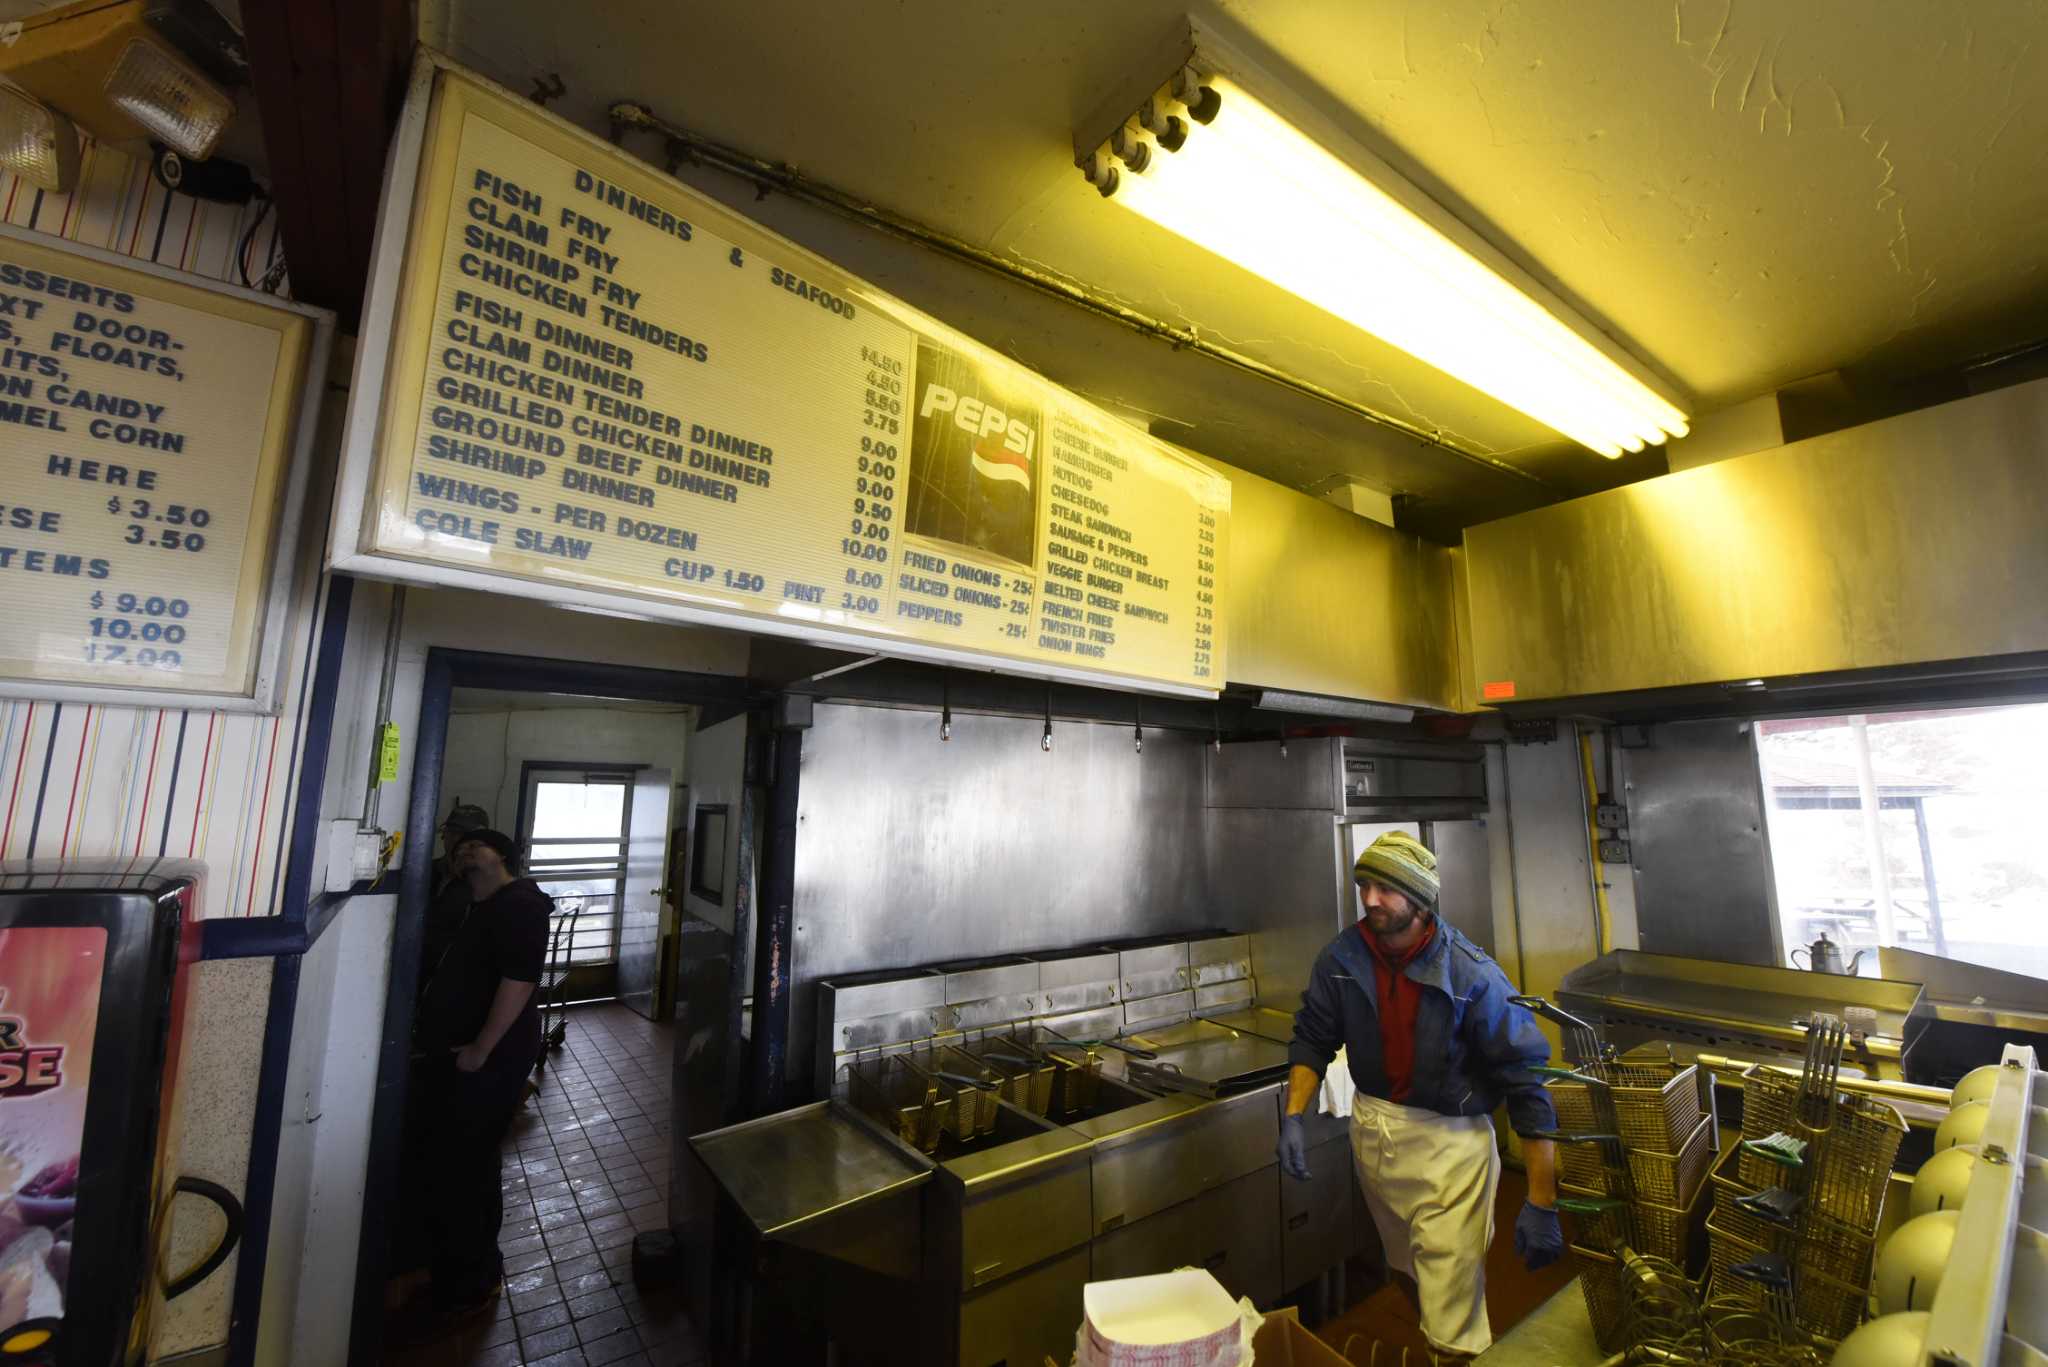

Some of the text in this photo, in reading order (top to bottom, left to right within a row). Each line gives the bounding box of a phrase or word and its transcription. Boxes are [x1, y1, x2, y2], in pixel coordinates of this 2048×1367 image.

[474, 168, 542, 217] FISH
[561, 207, 612, 246] FRY
[467, 197, 549, 247] CLAM
[568, 238, 620, 275] FRY
[575, 169, 857, 321] DINNERS & SEAFOOD
[1, 264, 135, 312] SSERTS
[464, 225, 580, 285] SHRIMP
[591, 275, 641, 311] FRY
[73, 311, 184, 350] DOOR-
[459, 253, 899, 435] CHICKEN TENDERS 3.75
[2, 348, 70, 382] ITS,
[51, 332, 184, 381] FLOATS,
[455, 290, 898, 461] FISH DINNER 9.00
[47, 384, 165, 423] CANDY
[442, 348, 894, 500] CHICKEN TENDER DINNER 9.00
[447, 320, 896, 481] CLAM DINNER 9.00
[920, 383, 1035, 461] PEPSI
[0, 400, 184, 453] MEL CORN
[436, 376, 893, 521] GRILLED CHICKEN DINNER 9.50
[48, 455, 157, 490] HERE
[431, 406, 890, 541] GROUND BEEF DINNER 9.00
[416, 472, 520, 515] WINGS
[554, 502, 606, 533] PER
[616, 514, 699, 552] DOZEN
[427, 435, 888, 563] SHRIMP DINNER 10.00
[1051, 484, 1109, 516] CHEESEDOG
[0, 505, 206, 552] SE 3.50
[1050, 522, 1096, 549] SAUSAGE
[1107, 542, 1148, 567] PEPPERS
[1051, 503, 1083, 524] STEAK
[1085, 511, 1132, 543] SANDWICH
[0, 546, 111, 579] TEMS
[415, 508, 880, 613] COLE SLAW CUP 1.50 PINT 3.00
[904, 551, 946, 575] FRIED
[952, 563, 1002, 588] ONIONS
[1047, 561, 1083, 583] VEGGIE
[1087, 573, 1123, 595] BURGER
[1048, 541, 1088, 565] GRILLED
[1093, 556, 1132, 580] CHICKEN
[1136, 571, 1169, 591] BREAST
[897, 601, 963, 627] PEPPERS
[899, 574, 949, 598] SLICED
[954, 586, 1002, 610] ONIONS
[1042, 600, 1083, 622] FRENCH
[1087, 611, 1114, 629] FRIES
[1045, 580, 1083, 602] MELTED
[1087, 592, 1120, 613] CHEESE
[1124, 603, 1169, 624] SANDWICH
[89, 616, 186, 644] 10.00
[1039, 635, 1072, 653] ONION
[1041, 617, 1085, 639] TWISTER
[1089, 628, 1115, 645] FRIES
